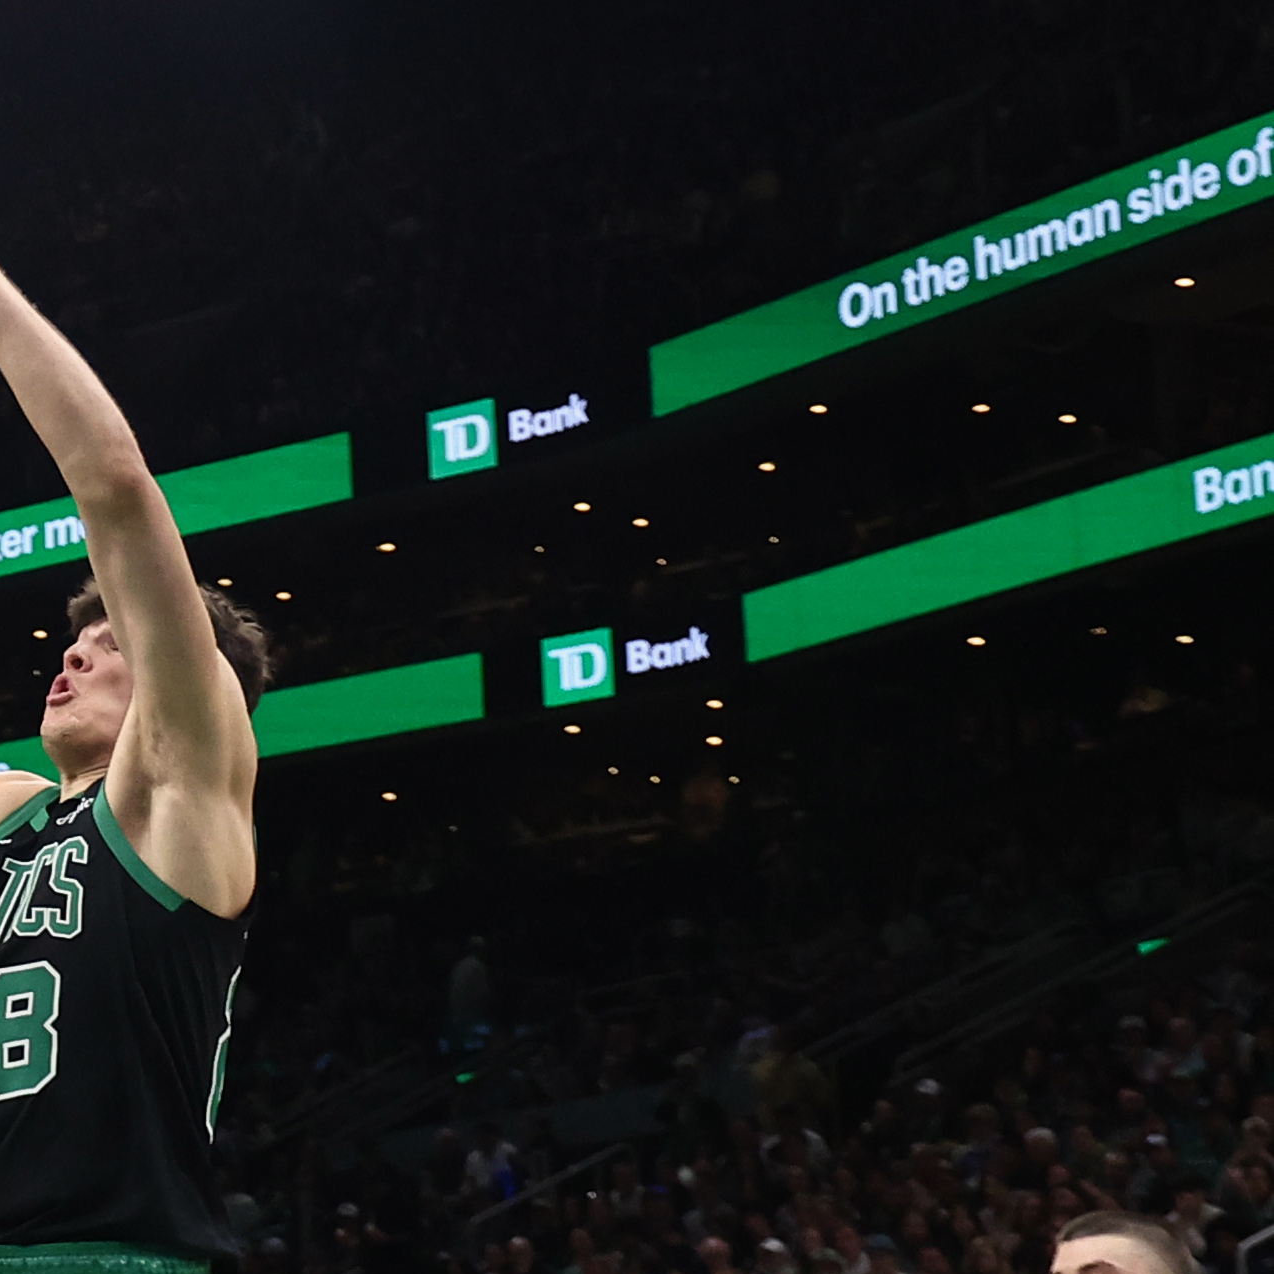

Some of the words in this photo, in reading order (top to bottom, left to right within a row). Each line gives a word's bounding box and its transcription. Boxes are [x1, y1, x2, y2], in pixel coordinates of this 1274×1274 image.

[838, 282, 898, 328] On
[901, 256, 969, 306] the
[973, 198, 1121, 281] human
[1127, 157, 1221, 224] side
[1226, 126, 1274, 187] of
[432, 414, 491, 463] TD
[508, 392, 590, 442] Bank
[547, 642, 607, 691] TD
[625, 625, 710, 674] Bank
